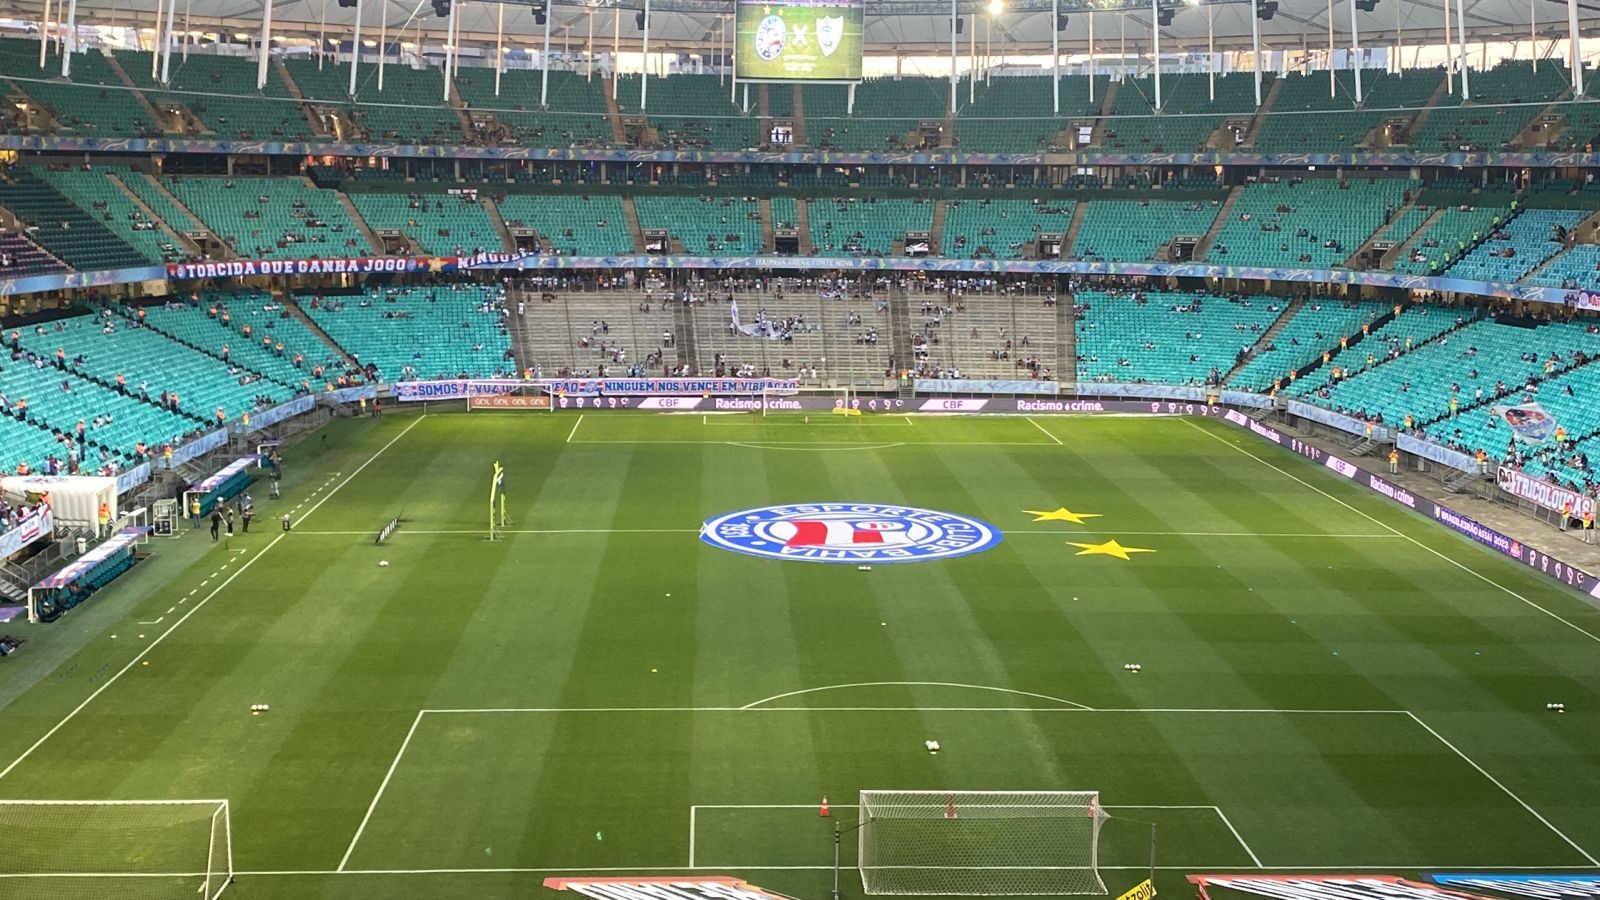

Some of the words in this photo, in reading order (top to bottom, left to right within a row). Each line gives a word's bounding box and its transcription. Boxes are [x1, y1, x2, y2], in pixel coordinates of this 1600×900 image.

[186, 261, 256, 279] TORCIDA
[260, 261, 294, 274] QUE
[298, 259, 359, 274] GANHA
[363, 258, 406, 272] JOGO
[755, 259, 786, 267] ITAIPAVA
[788, 259, 811, 267] ARENA
[835, 259, 854, 267] NOVA
[418, 383, 459, 397] SOMOS
[658, 381, 680, 392] NOS
[683, 381, 720, 392] VENCE
[721, 381, 738, 392] EM
[474, 397, 491, 407] GOL
[493, 397, 509, 407] GOL
[511, 397, 528, 407] GOL
[529, 397, 546, 407] GOL
[658, 398, 680, 408] CBF
[715, 397, 761, 409] Racismo
[942, 400, 963, 409] CBF
[1017, 399, 1062, 411] Racismo
[1370, 474, 1394, 498] Racismo
[769, 504, 952, 523] ESPORTE
[1441, 510, 1479, 536] BRASILEIRÃO
[1493, 535, 1509, 550] 2023
[915, 523, 978, 553] CLUBE
[780, 547, 914, 558] BAHIA
